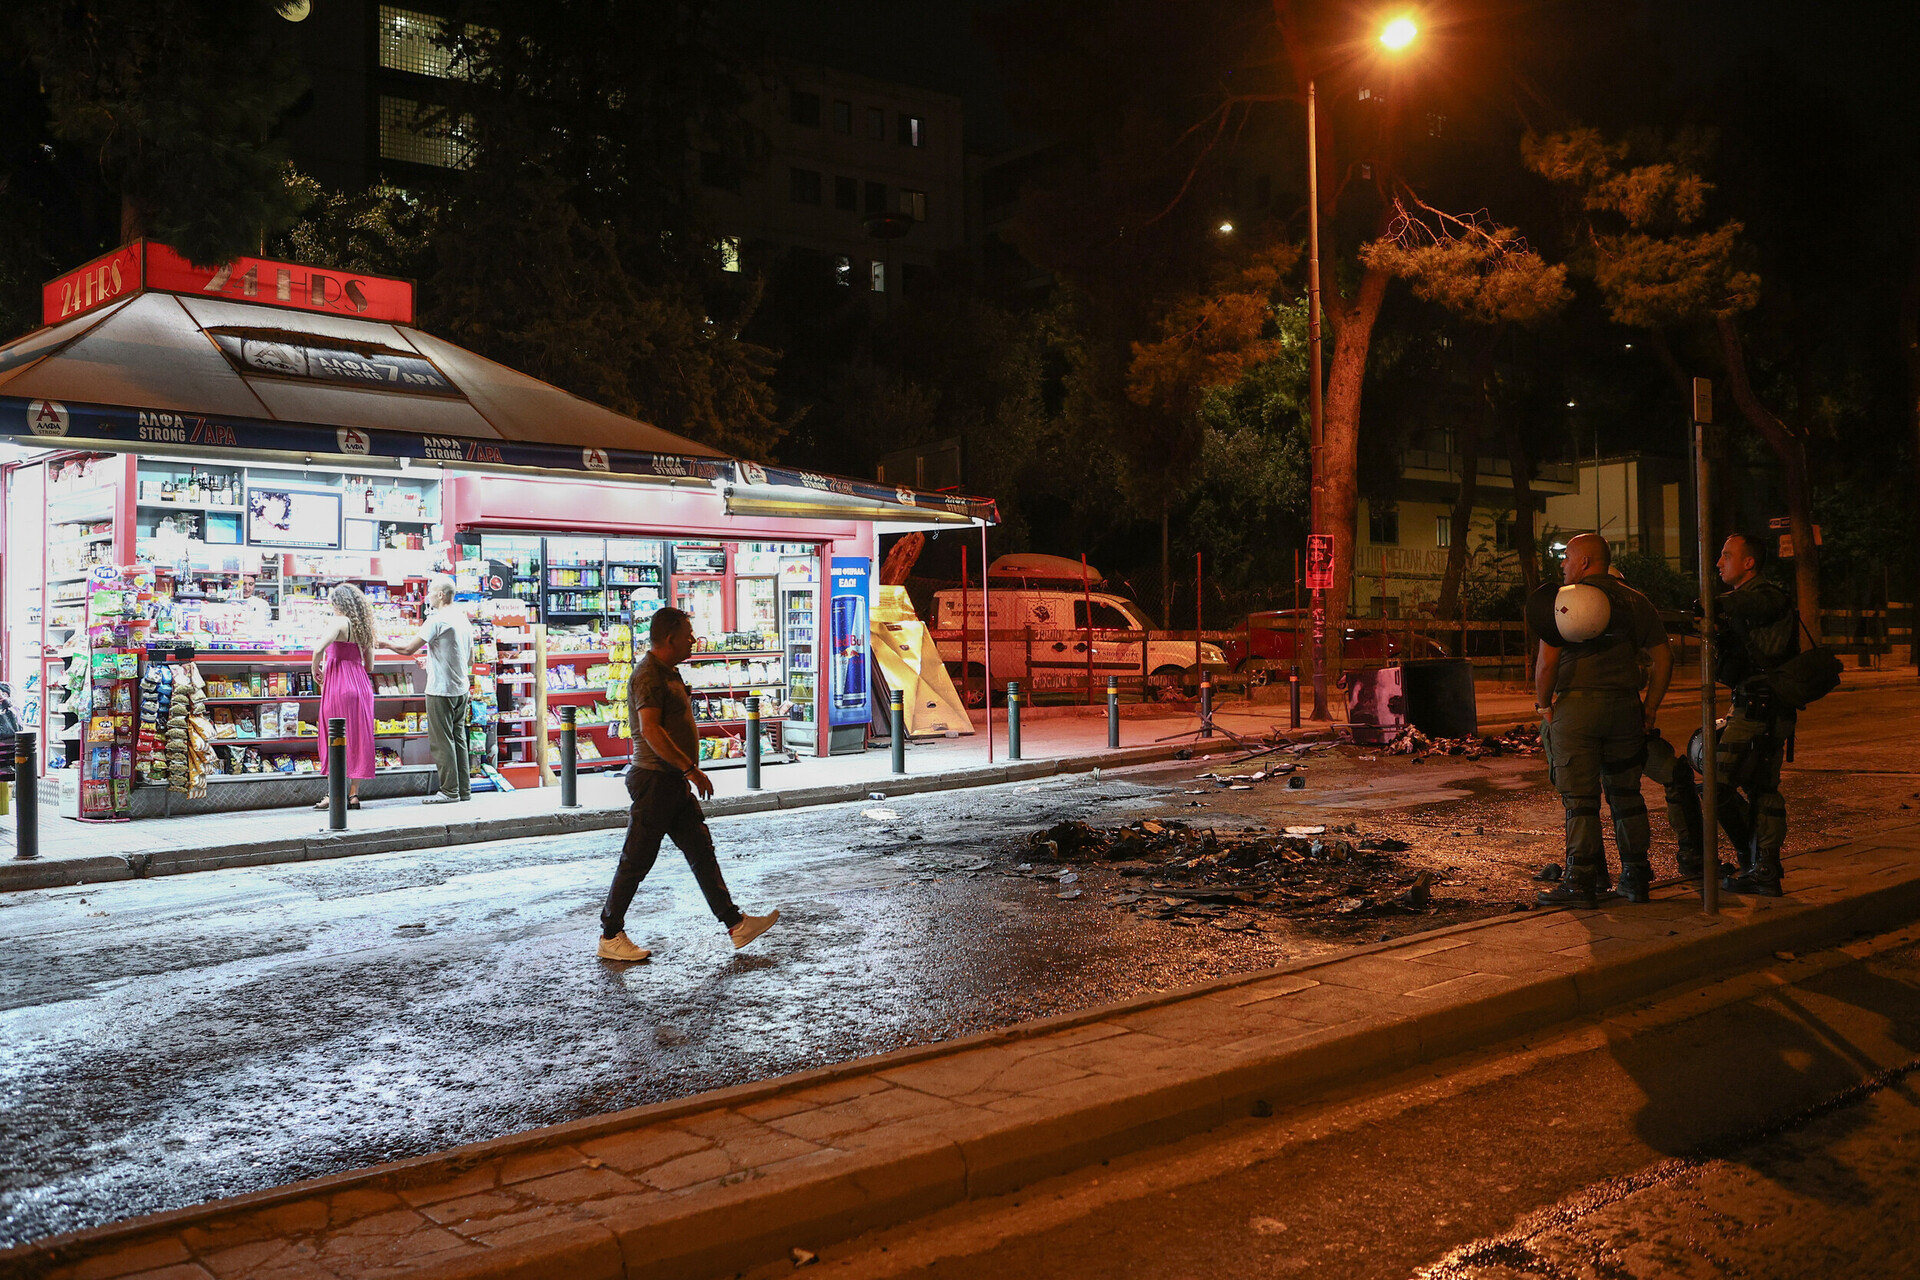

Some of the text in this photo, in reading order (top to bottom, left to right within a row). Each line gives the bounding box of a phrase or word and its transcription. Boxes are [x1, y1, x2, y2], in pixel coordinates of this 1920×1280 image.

[60, 258, 123, 317] 24 HRS
[203, 263, 368, 314] 24 HRS
[139, 426, 186, 442] STRONG
[425, 448, 463, 461] STRONG
[653, 466, 687, 477] STRONG
